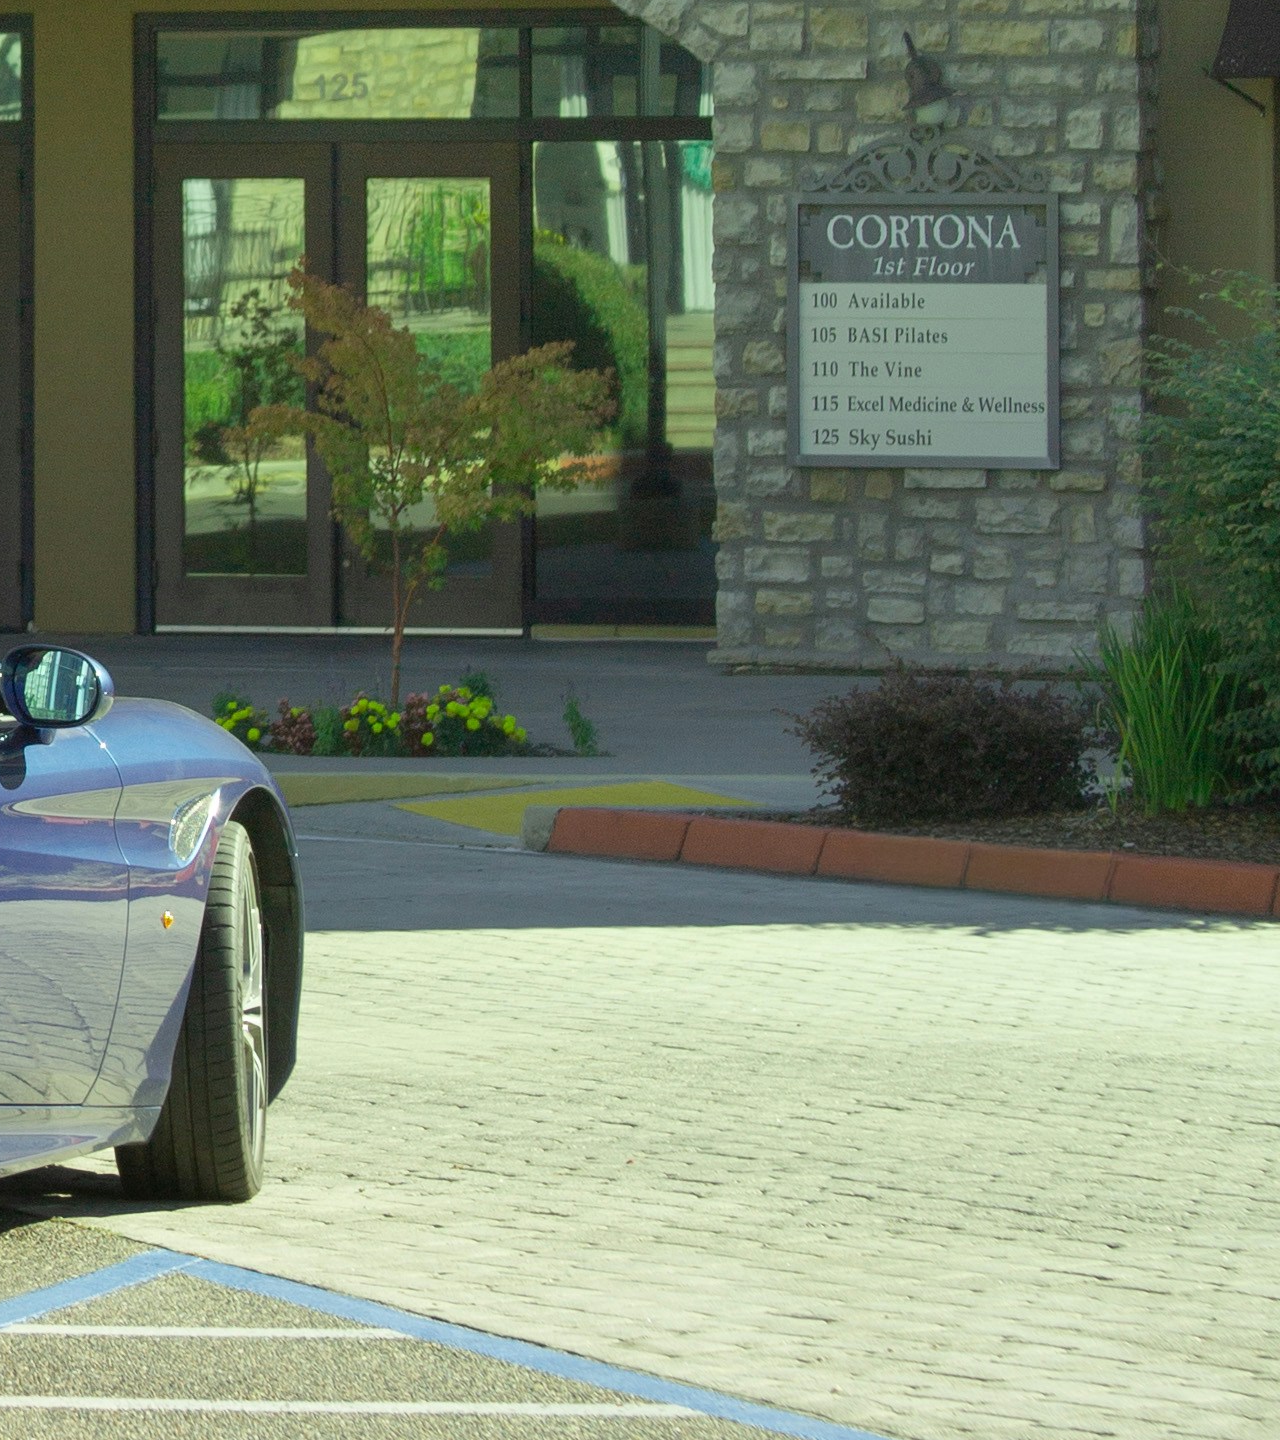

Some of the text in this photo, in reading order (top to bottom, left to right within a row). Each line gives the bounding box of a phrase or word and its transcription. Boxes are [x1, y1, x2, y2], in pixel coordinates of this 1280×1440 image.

[313, 72, 368, 101] 125
[826, 214, 1021, 249] CORTONA
[873, 256, 975, 276] 1st Floor
[812, 292, 925, 309] 100 Available
[811, 327, 948, 344] 105 BASI Pilates
[811, 361, 922, 378] 110 The Vine
[811, 396, 1045, 414] 115 Excel Medicine & Wellness
[812, 428, 932, 450] 125 Sky Sushi
